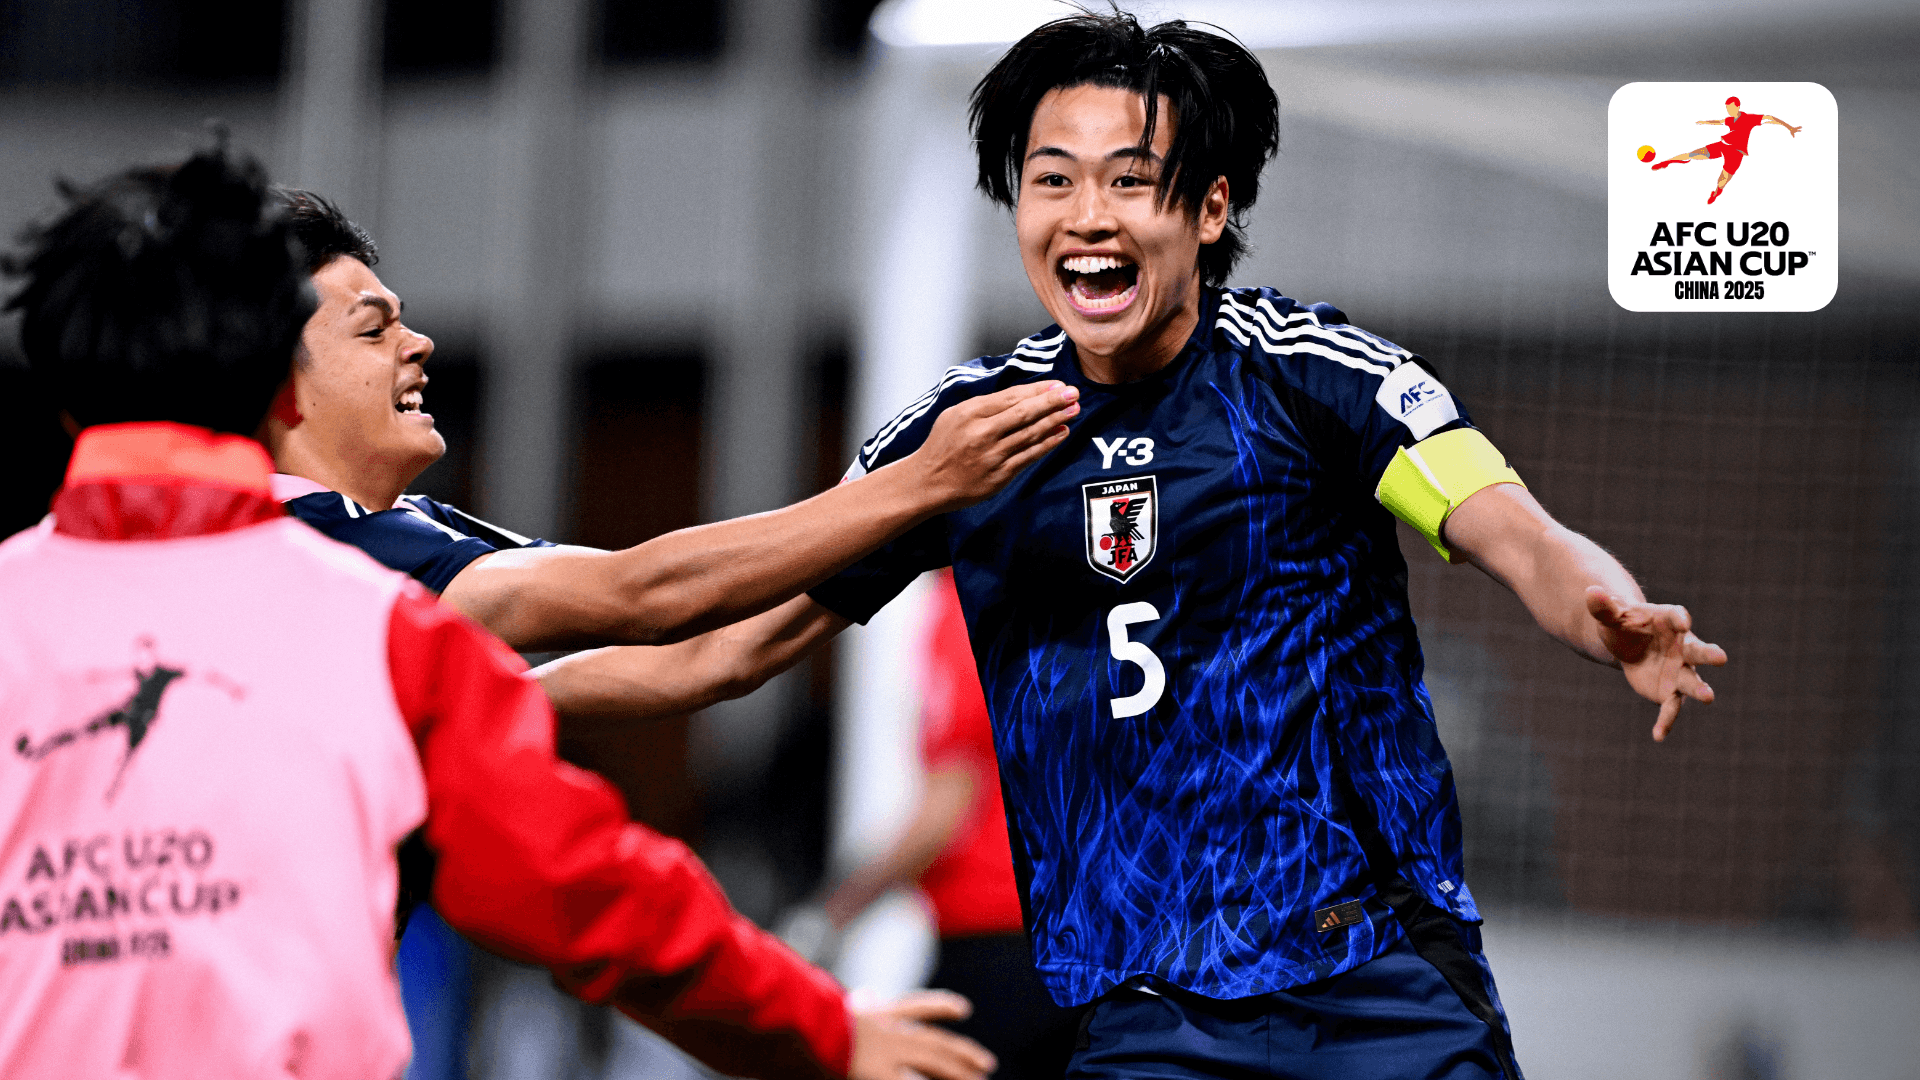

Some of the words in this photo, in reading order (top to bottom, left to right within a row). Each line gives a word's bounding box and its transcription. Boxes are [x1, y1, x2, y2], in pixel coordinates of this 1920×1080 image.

[1400, 380, 1436, 415] AFC
[1091, 437, 1155, 469] Y-3
[1101, 482, 1139, 495] JAPAN
[1107, 547, 1139, 566] JFA
[1107, 601, 1166, 719] 5
